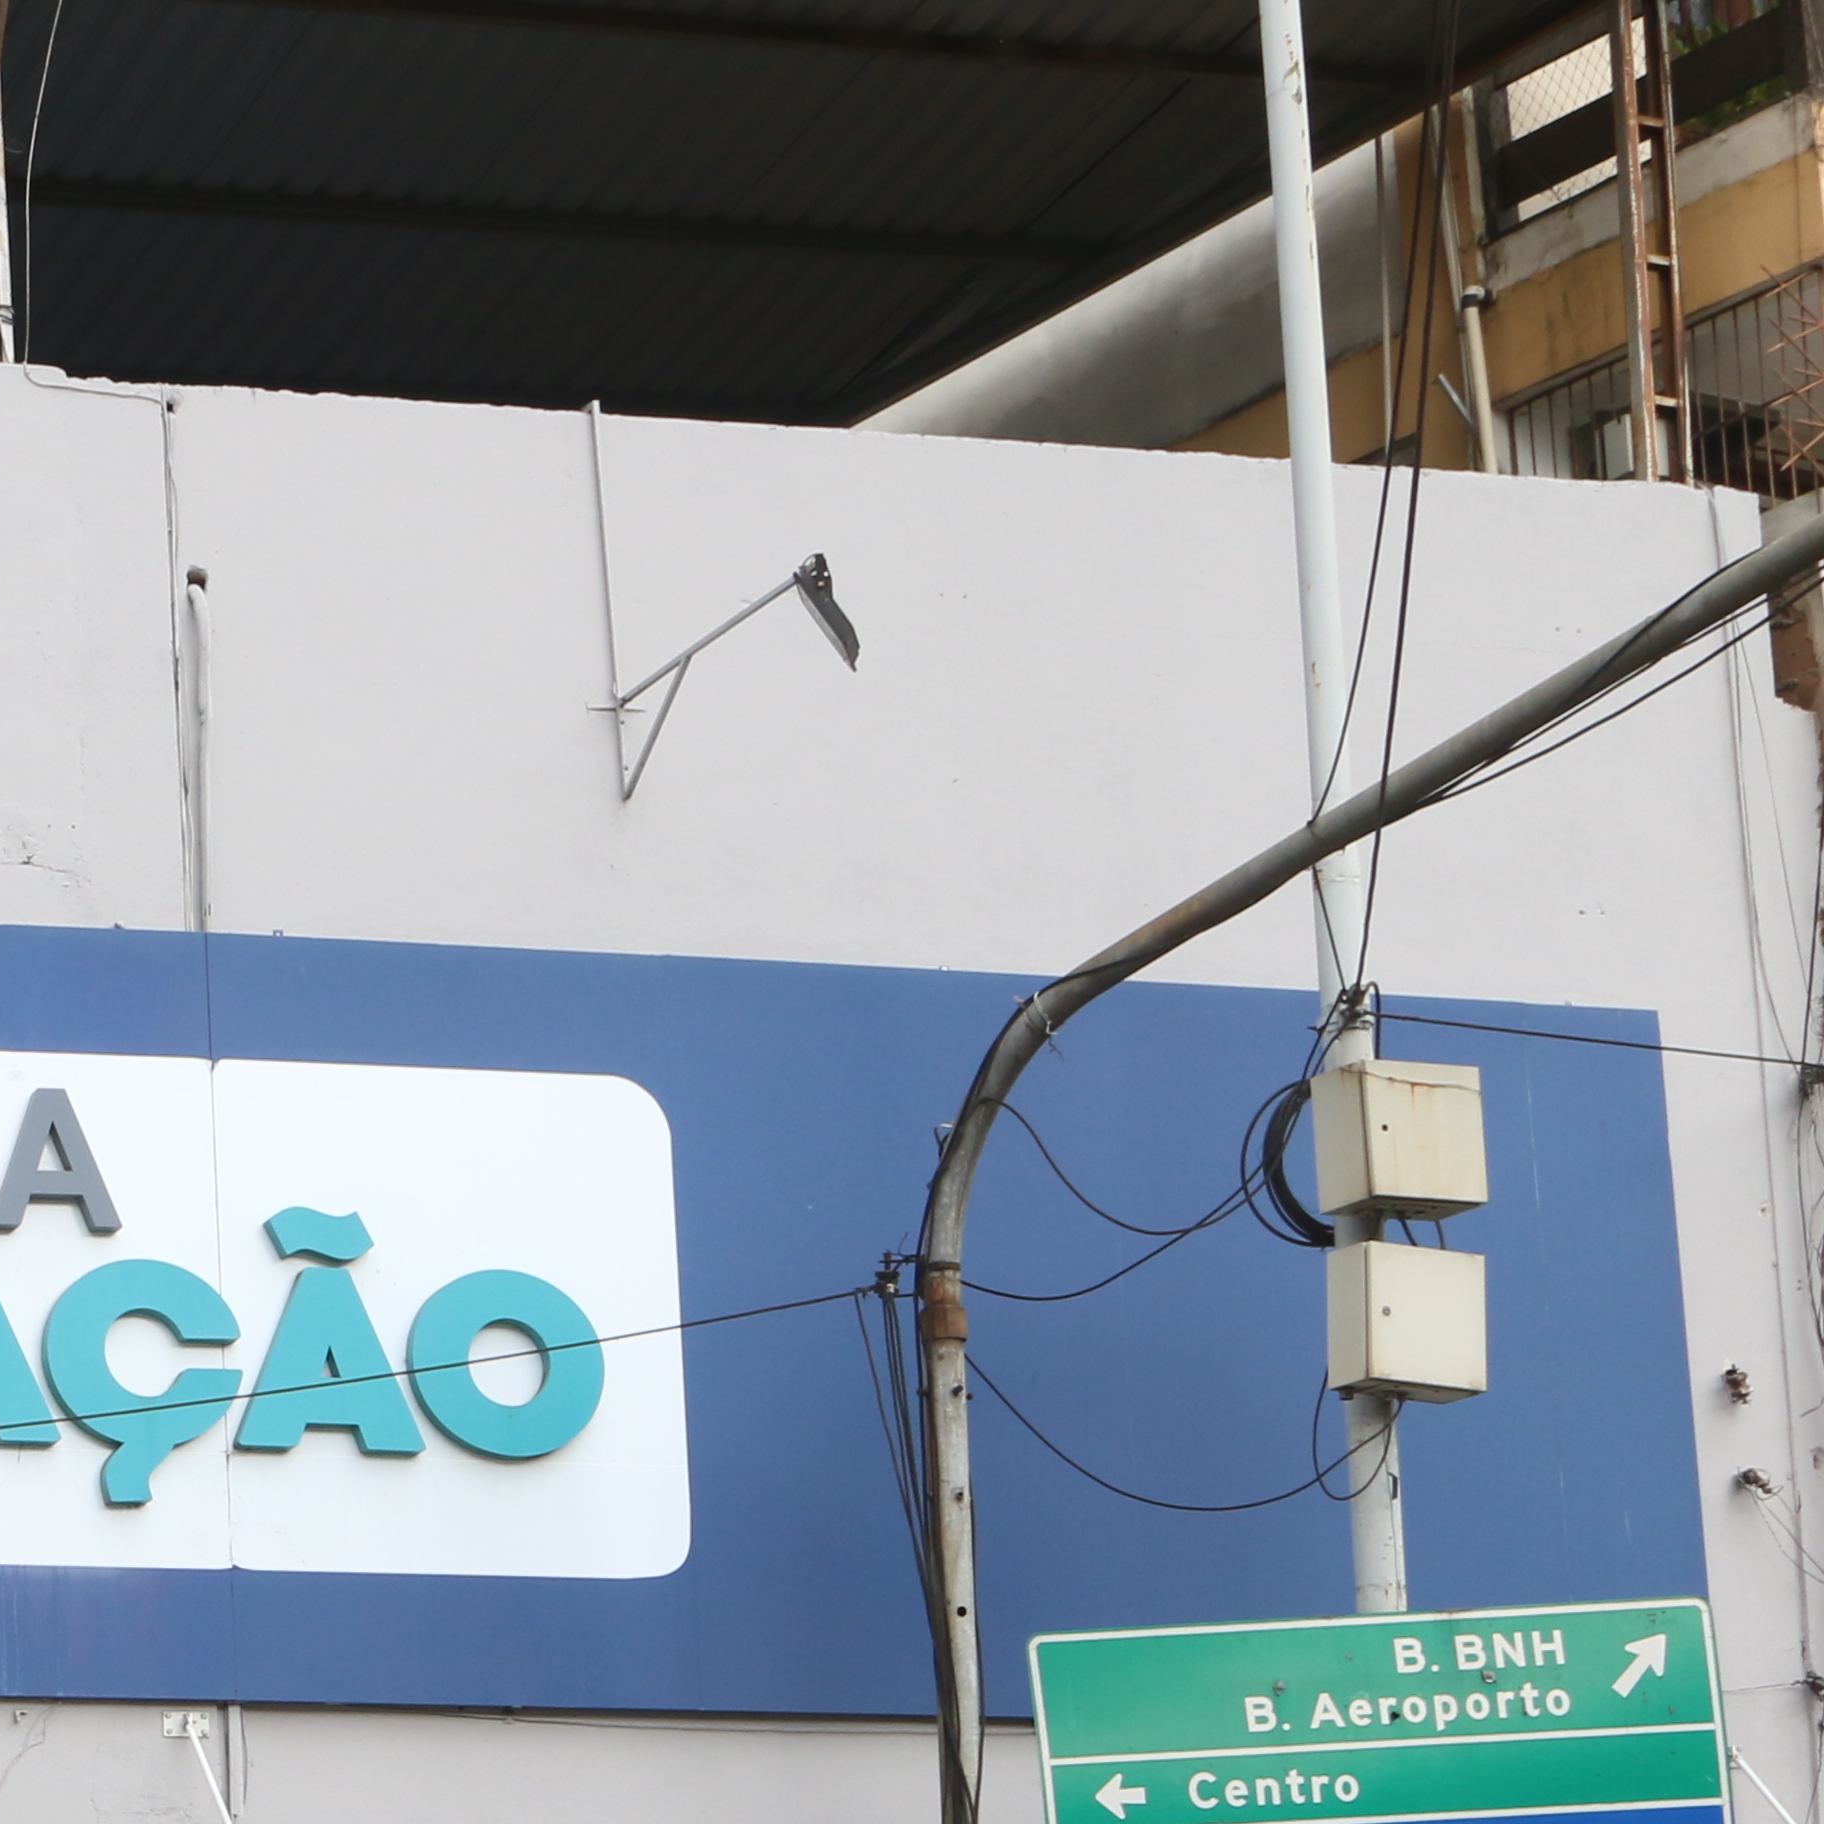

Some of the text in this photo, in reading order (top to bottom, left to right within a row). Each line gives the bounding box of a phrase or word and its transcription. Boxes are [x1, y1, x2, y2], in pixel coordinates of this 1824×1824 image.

[1392, 1629, 1567, 1675] B. BNH
[1244, 1681, 1571, 1733] B. Aeroporto
[1188, 1768, 1360, 1810] Centro
